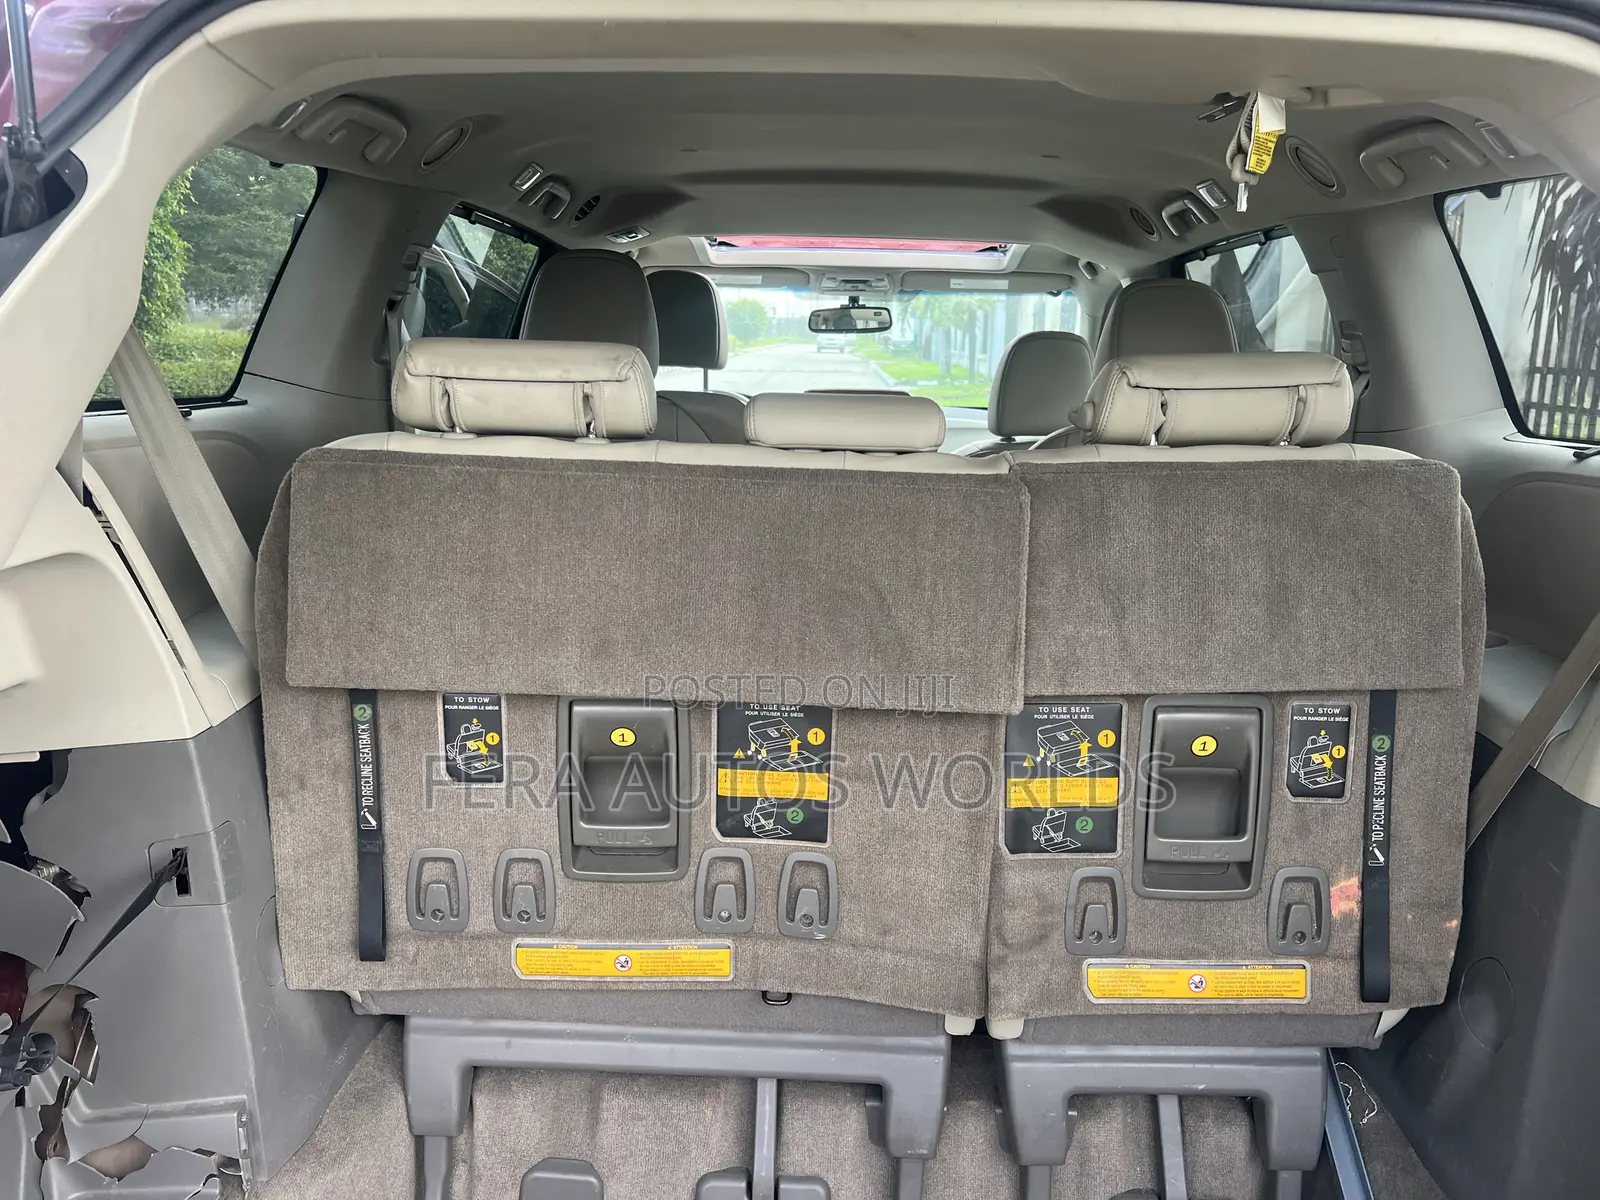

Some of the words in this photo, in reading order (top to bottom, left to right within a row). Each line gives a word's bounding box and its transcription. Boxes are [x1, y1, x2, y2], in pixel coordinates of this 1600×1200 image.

[357, 723, 372, 763] SEATBACK
[360, 763, 374, 797] RECLINE
[1373, 754, 1388, 796] SEATBACK
[362, 797, 375, 807] TO
[596, 831, 632, 845] PULL
[1371, 829, 1384, 842] TO
[1169, 844, 1208, 860] PULL
